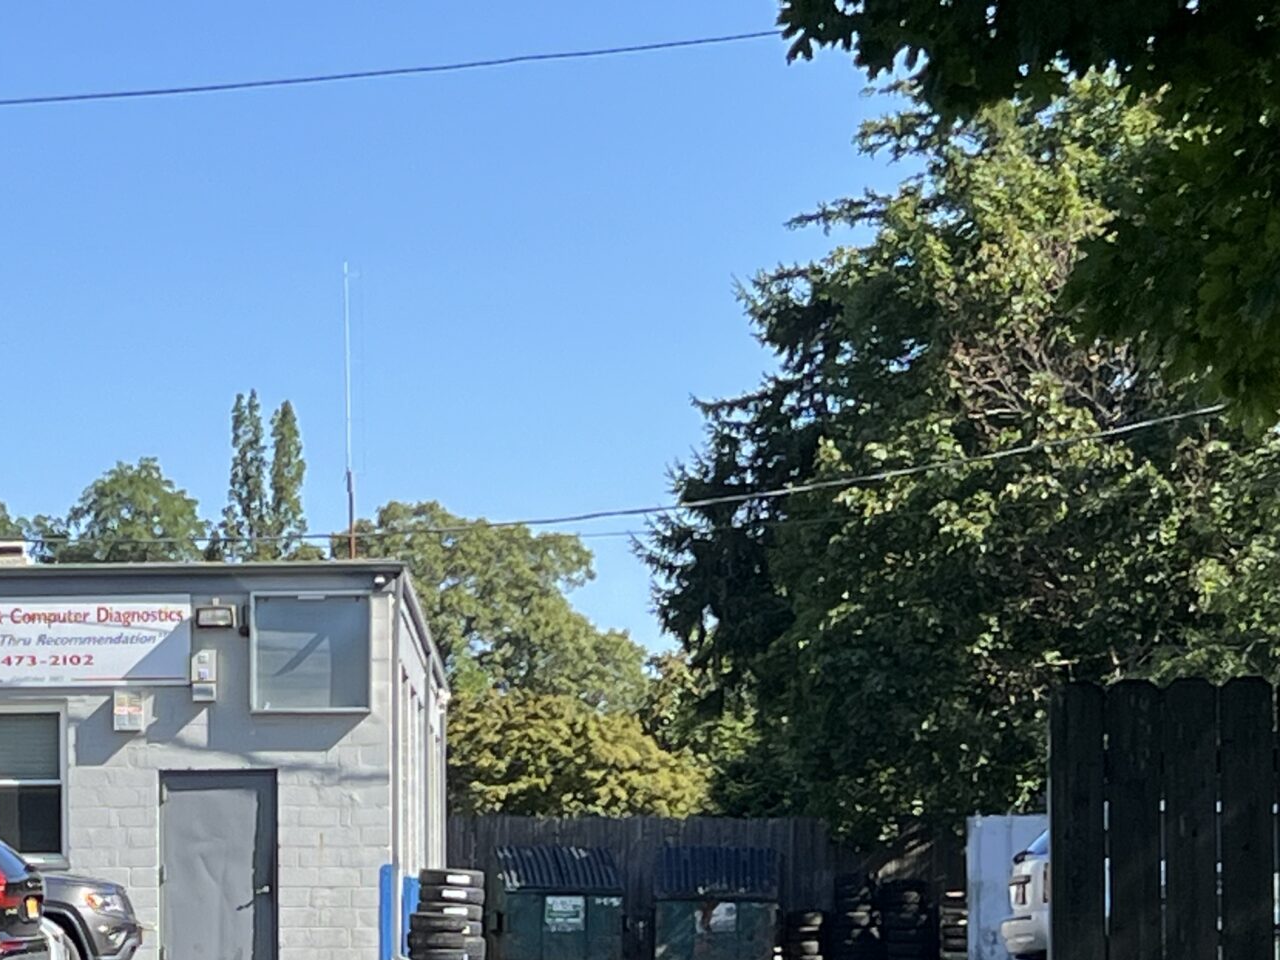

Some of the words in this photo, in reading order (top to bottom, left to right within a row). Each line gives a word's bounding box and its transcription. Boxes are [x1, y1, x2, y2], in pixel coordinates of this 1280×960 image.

[10, 608, 90, 628] Computer
[97, 607, 183, 627] Diagnostics
[0, 634, 31, 646] Thru
[1, 655, 94, 666] 473-2102
